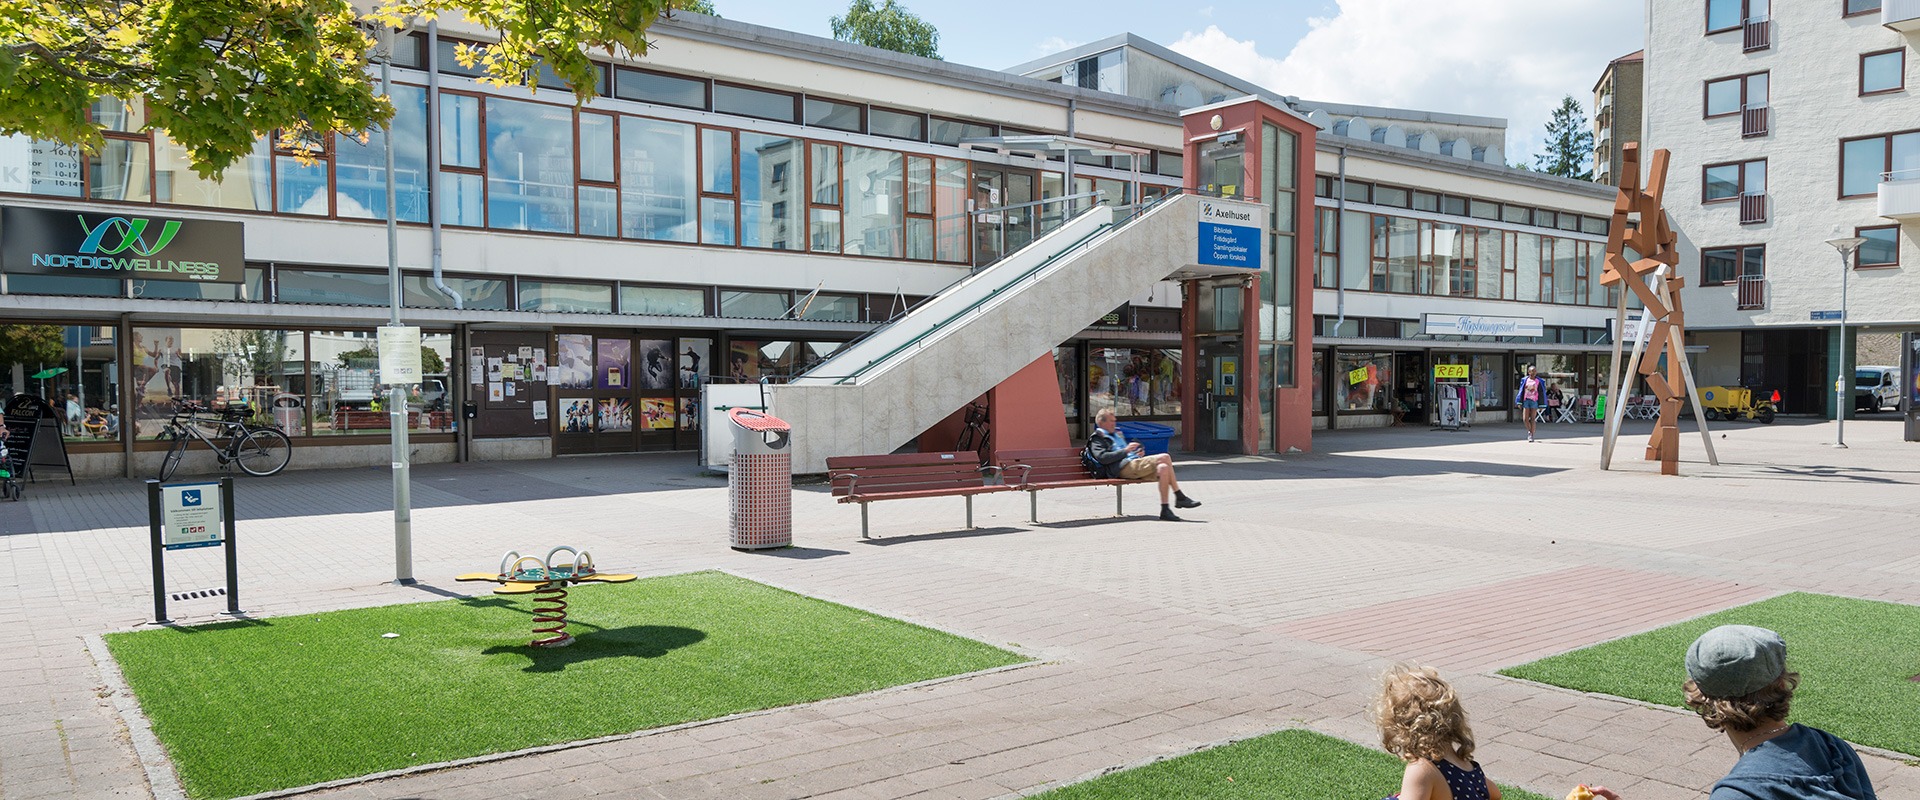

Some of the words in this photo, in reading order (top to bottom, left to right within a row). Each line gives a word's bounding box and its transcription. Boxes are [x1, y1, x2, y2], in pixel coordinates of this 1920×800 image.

[54, 161, 78, 170] 10-19
[55, 170, 78, 178] 10-17
[55, 179, 79, 187] 10-14
[1215, 209, 1250, 221] Axelhuset
[1213, 244, 1247, 252] Samlingslokaler
[1213, 251, 1229, 260] Öppen
[1352, 369, 1368, 381] REA
[1436, 366, 1464, 377] REA
[10, 408, 35, 417] FALCON
